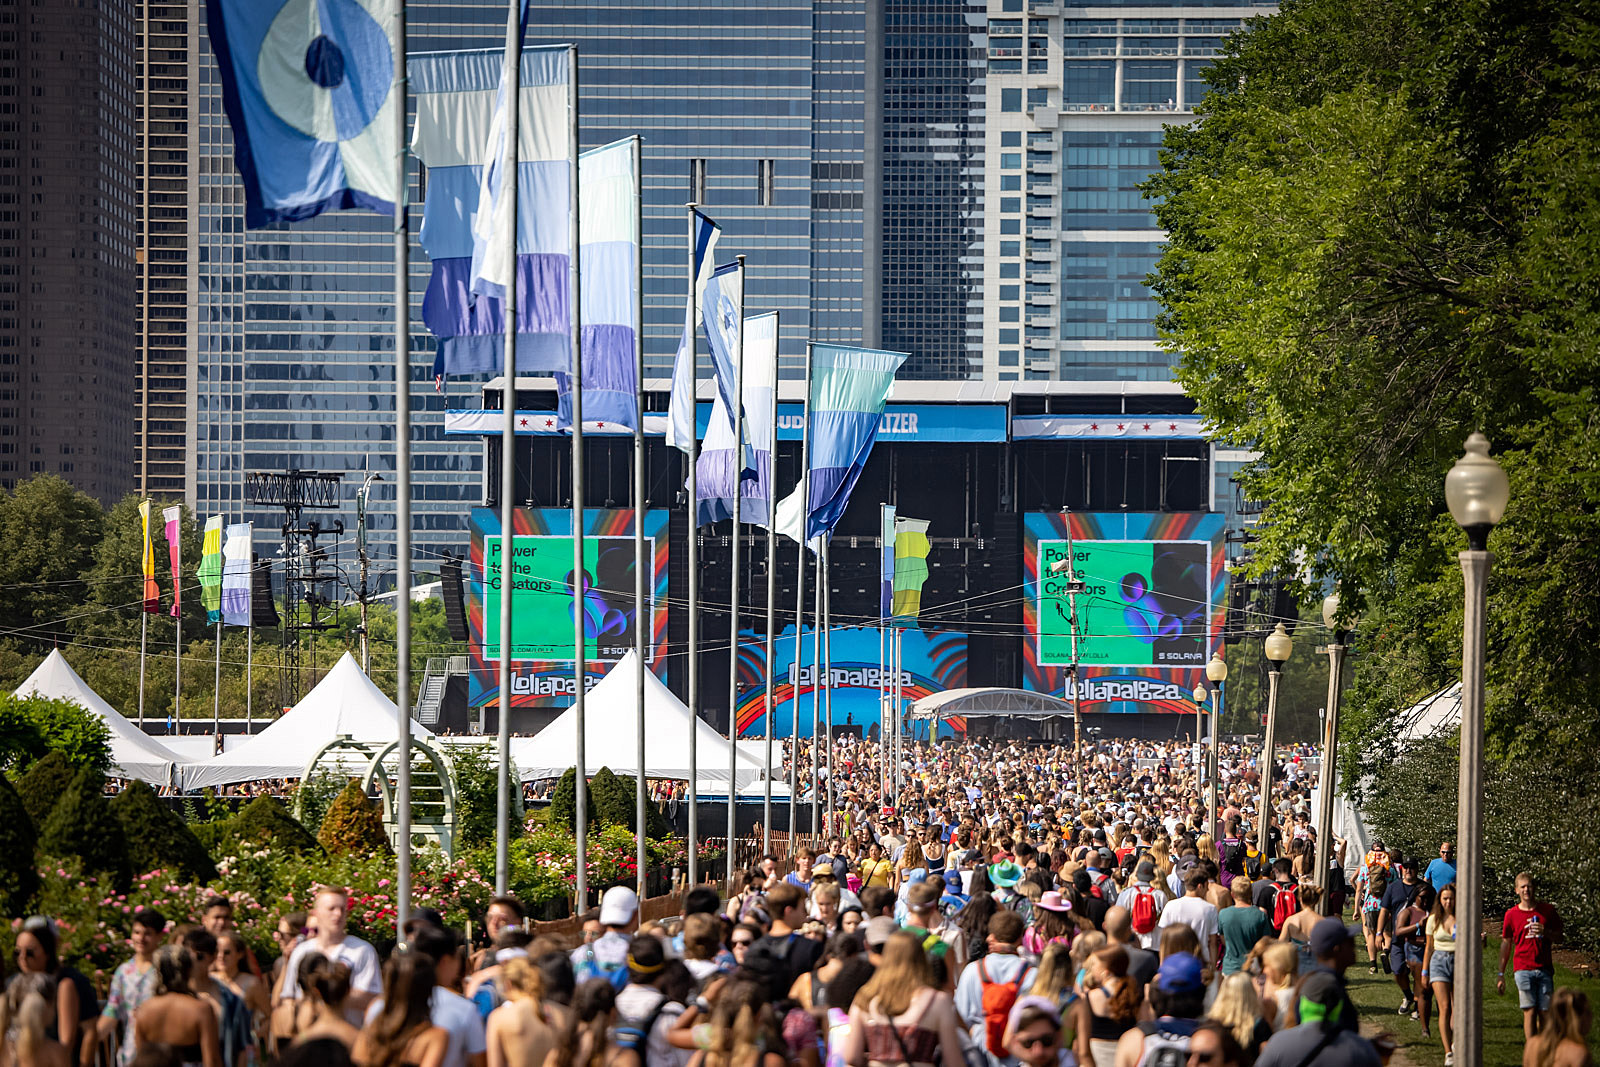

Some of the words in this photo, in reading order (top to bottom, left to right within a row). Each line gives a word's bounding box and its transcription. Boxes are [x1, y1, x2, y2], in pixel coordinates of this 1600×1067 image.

[776, 415, 804, 429] UD
[878, 413, 919, 434] LTZER
[491, 543, 537, 557] Pwer
[511, 561, 532, 574] he
[490, 577, 552, 591] Ceators
[1166, 652, 1203, 660] SOLANA
[788, 662, 916, 689] Lolapalooza
[1064, 677, 1183, 703] Lollapalooza
